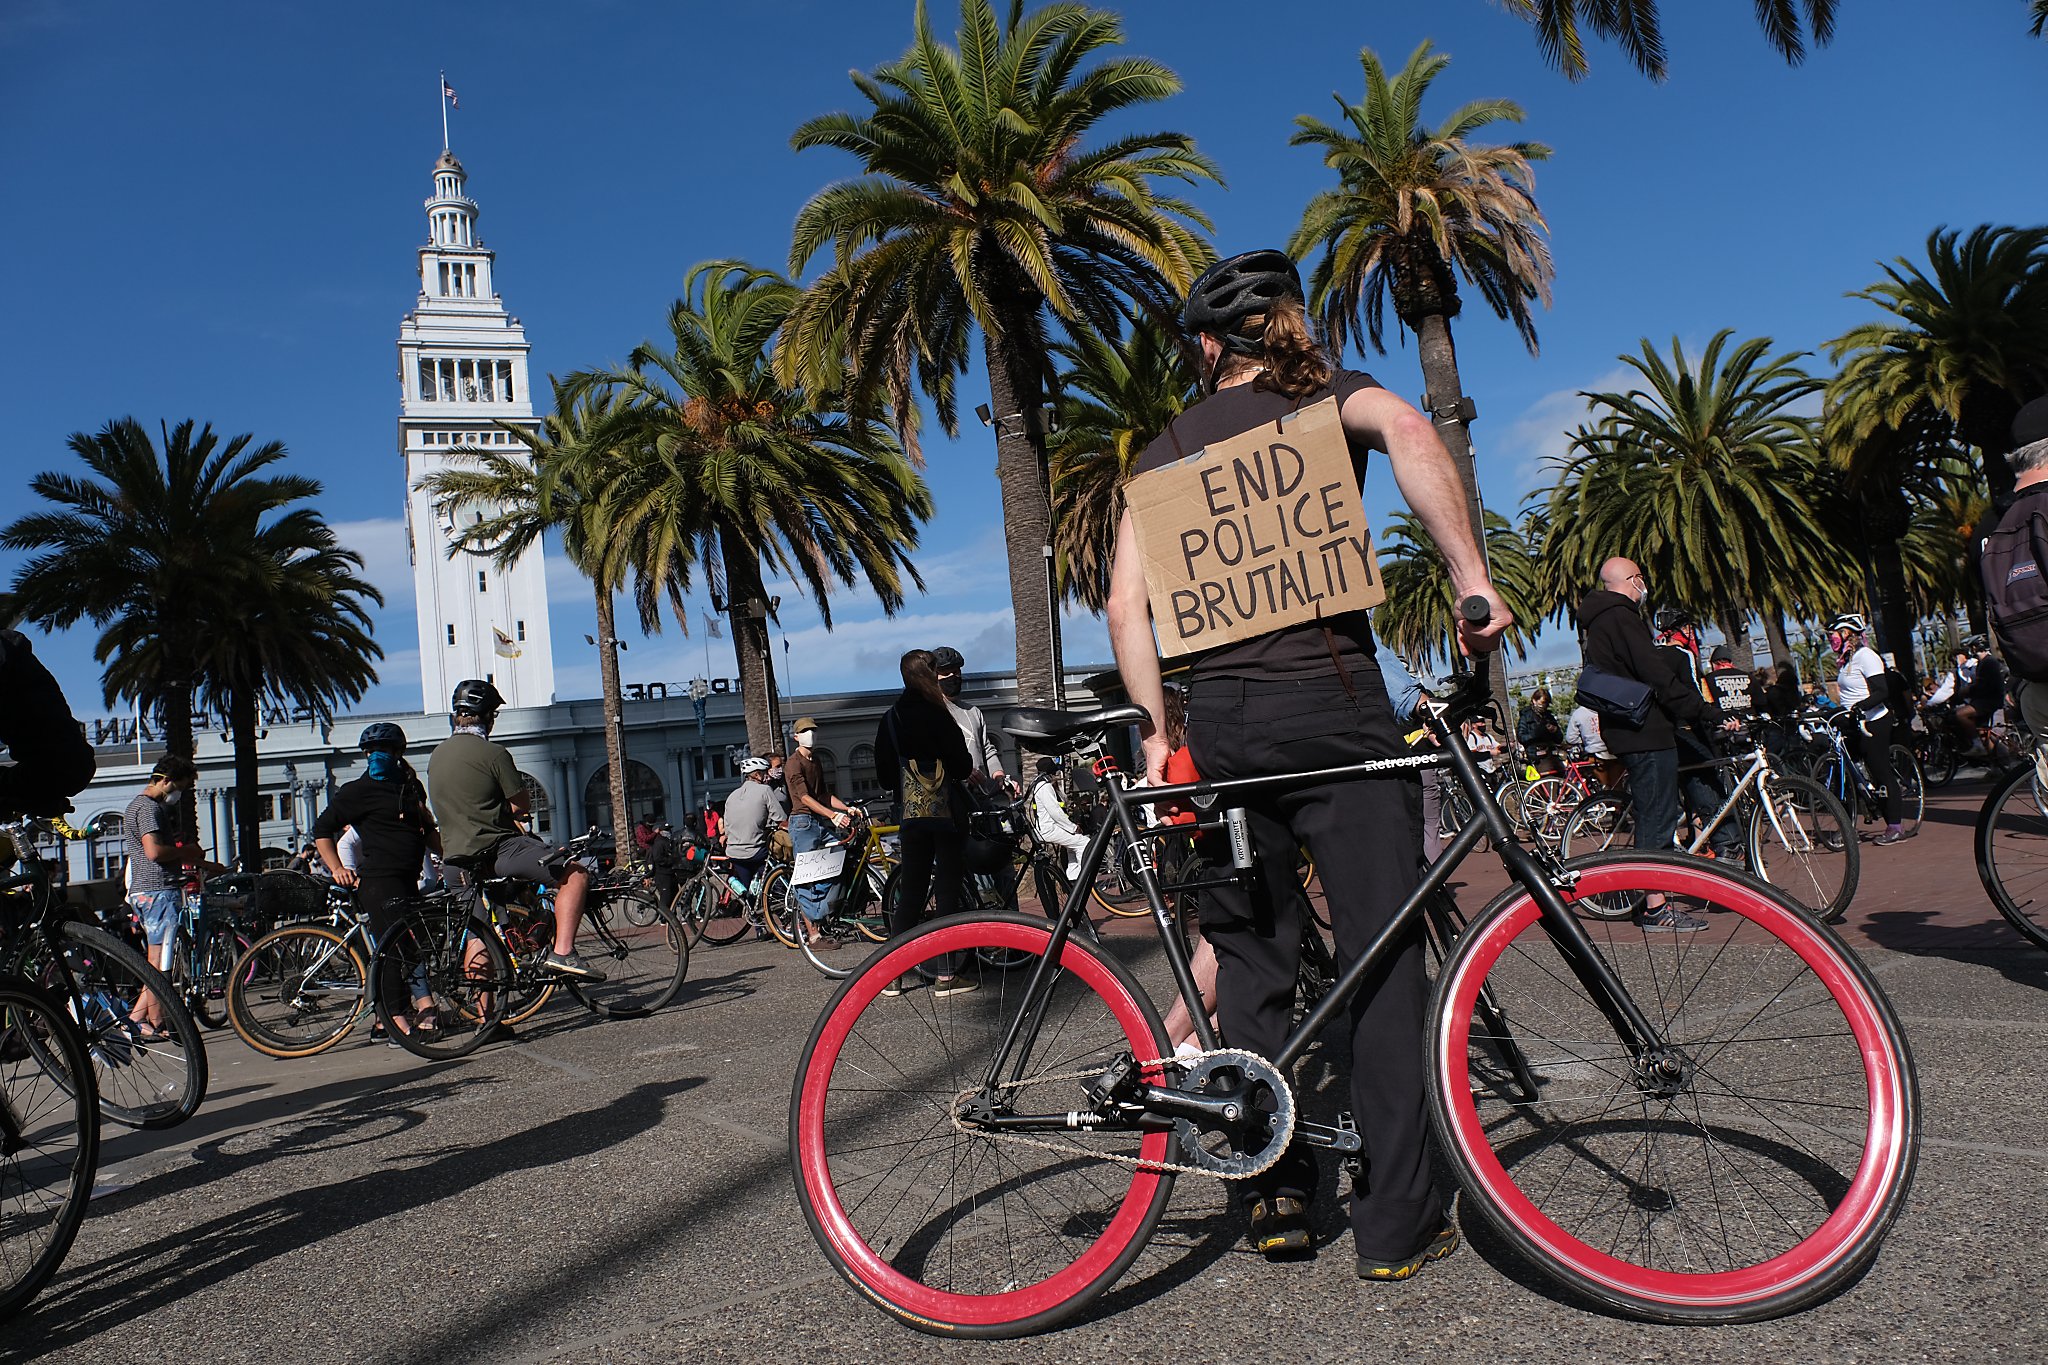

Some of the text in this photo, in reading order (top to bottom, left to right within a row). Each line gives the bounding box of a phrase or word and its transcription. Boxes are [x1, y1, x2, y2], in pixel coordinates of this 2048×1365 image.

[1200, 443, 1305, 516] END
[1180, 481, 1349, 580] POLICE
[1171, 528, 1374, 638] BRUTALITY
[1715, 677, 1751, 687] DONALD
[1365, 753, 1439, 771] Retrospec
[797, 852, 827, 867] BLACK
[1233, 820, 1245, 861] KRYPTONITE
